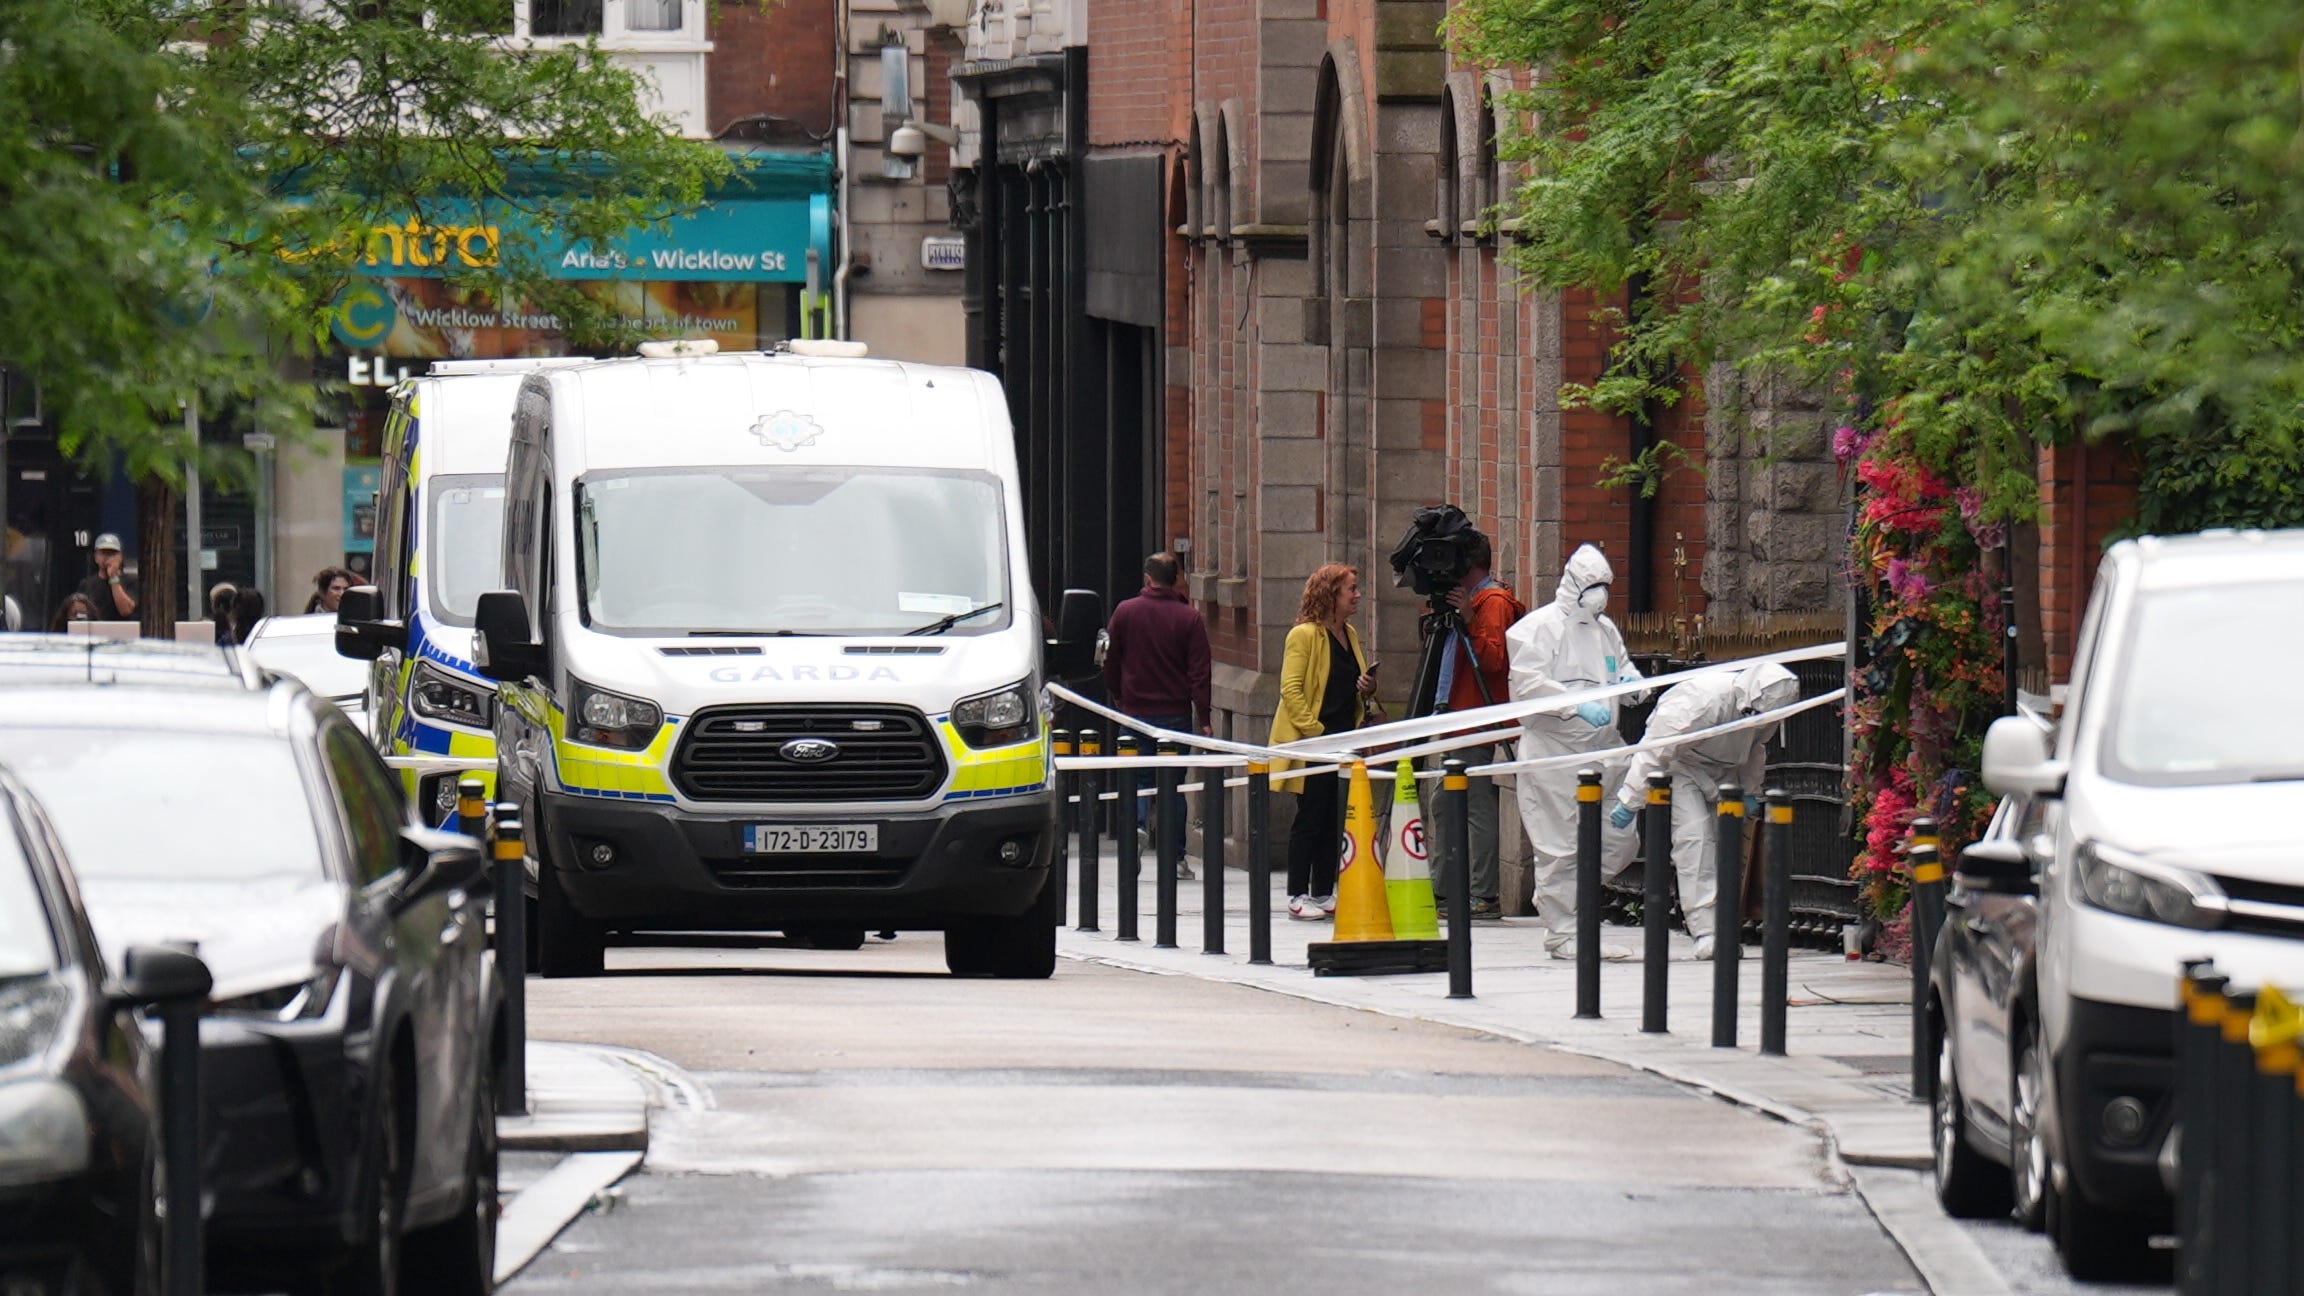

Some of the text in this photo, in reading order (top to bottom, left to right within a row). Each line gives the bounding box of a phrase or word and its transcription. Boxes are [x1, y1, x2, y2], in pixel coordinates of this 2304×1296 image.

[652, 249, 755, 270] Wicklow
[761, 250, 786, 271] St
[416, 308, 495, 327] Wicklow
[501, 310, 562, 330] Street,
[672, 313, 691, 330] of
[695, 315, 737, 330] town
[74, 530, 88, 547] 10
[709, 665, 901, 683] GARDA
[792, 743, 826, 758] Ford
[764, 830, 868, 850] 172-D-23179
